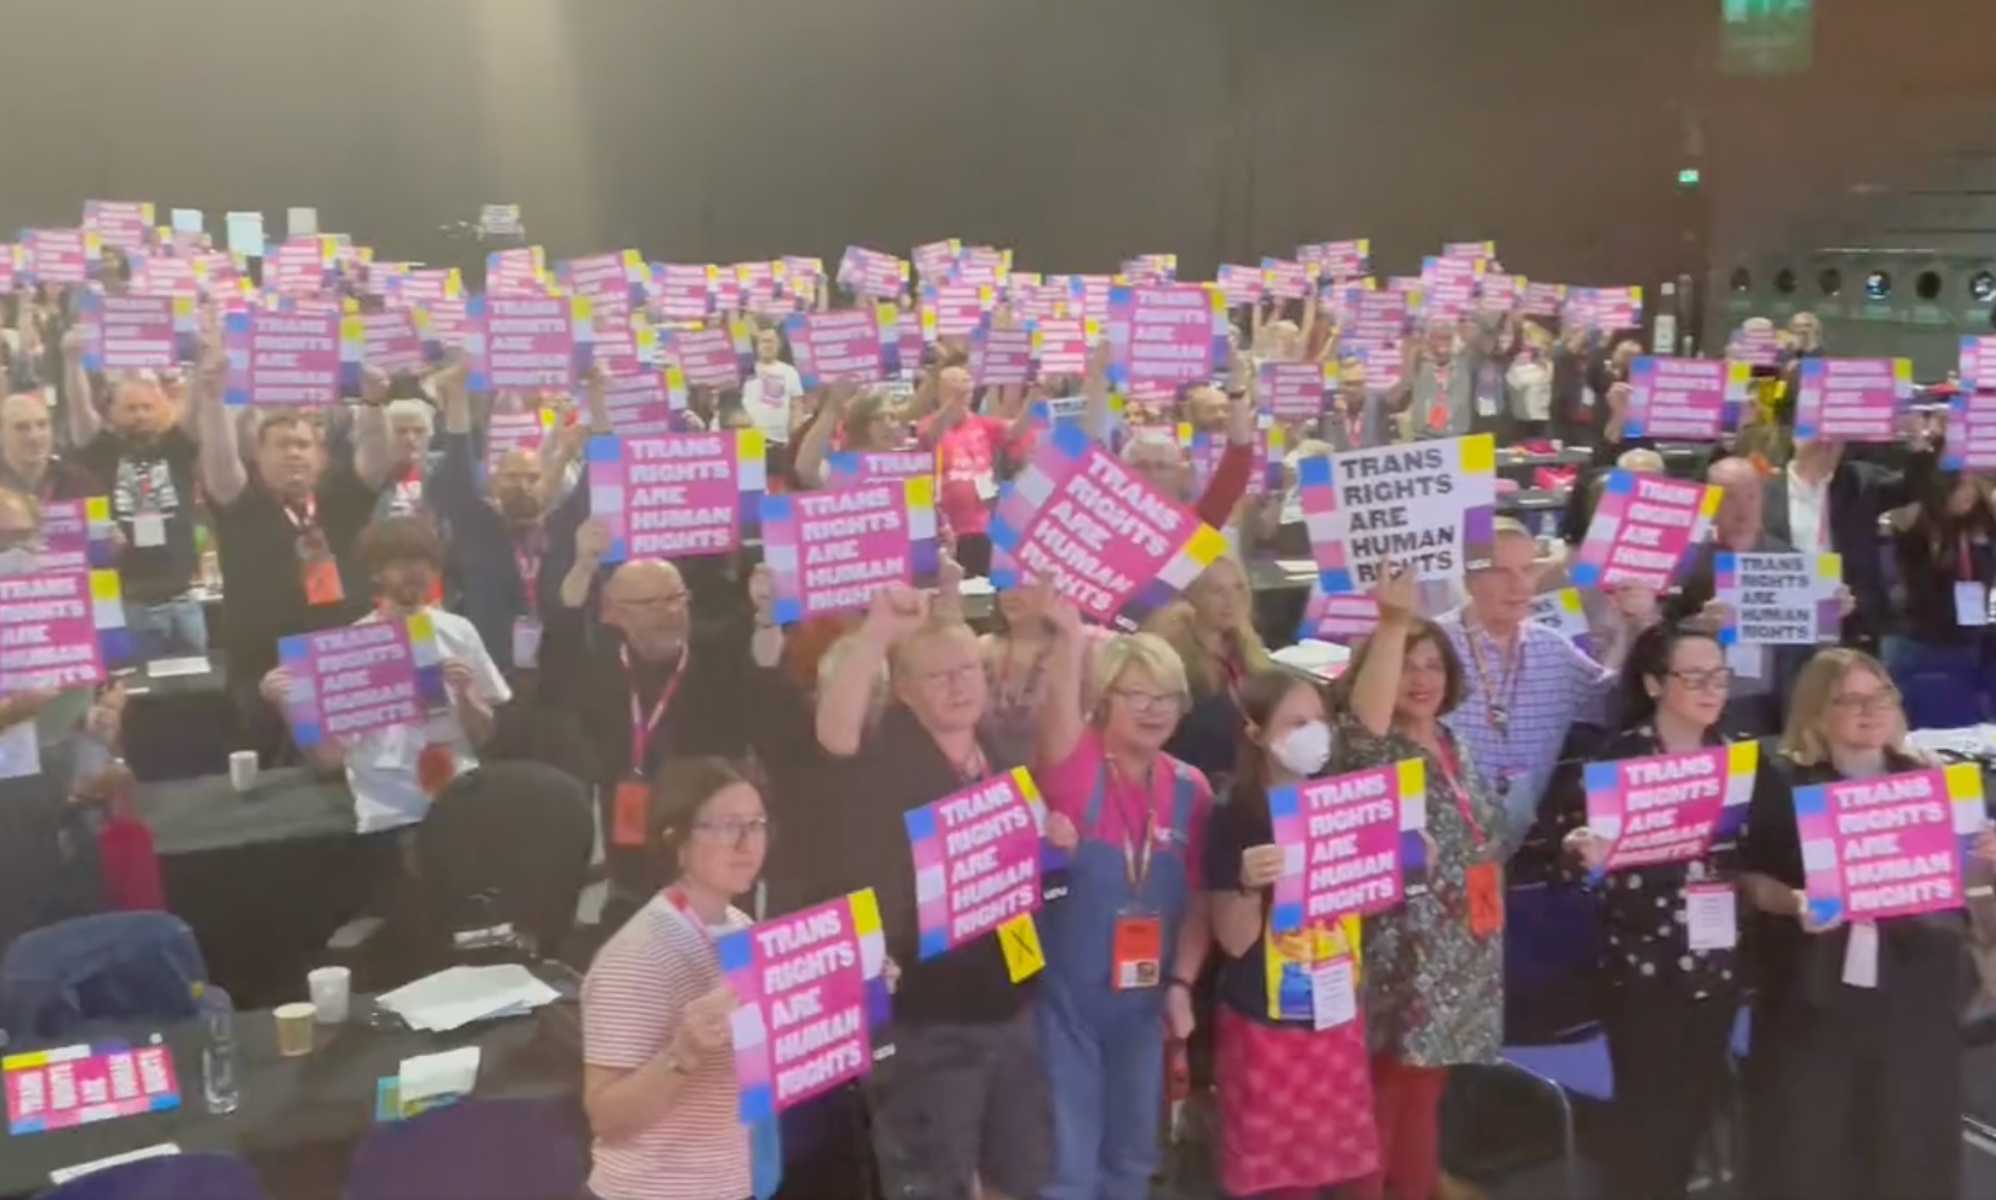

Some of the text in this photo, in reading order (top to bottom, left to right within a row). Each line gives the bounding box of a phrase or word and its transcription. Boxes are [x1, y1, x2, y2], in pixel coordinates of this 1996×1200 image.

[627, 437, 722, 460] TRANS
[1340, 448, 1443, 479] TRANS
[629, 460, 730, 483] RIGHTS
[631, 486, 688, 506] ARE
[799, 487, 890, 516] TRANS
[1087, 450, 1182, 531] TRANS
[1343, 474, 1454, 506] RIGHTS
[631, 507, 732, 530] HUMAN
[803, 511, 900, 541] RIGHTS
[1050, 500, 1111, 551] ARE
[1064, 473, 1170, 557] RIGHTS
[1350, 506, 1409, 533] ARE
[632, 528, 730, 554] RIGHTS
[806, 540, 859, 564] ARE
[1033, 518, 1135, 593] HUMAN
[1352, 525, 1455, 558] HUMAN
[806, 557, 905, 588] HUMAN
[1741, 555, 1803, 571] TRANS
[808, 580, 902, 610] RIGH
[1741, 574, 1809, 588] RIGHTS
[1742, 591, 1776, 605] ARE
[1742, 609, 1809, 622] HUMAN
[1742, 625, 1808, 639] RIGHTS
[1625, 755, 1715, 785] TRANS
[940, 781, 1014, 827] TRANS
[1304, 774, 1386, 810] TRANS
[1627, 777, 1720, 812] RIGHTS
[1833, 776, 1932, 808] TRANS
[946, 805, 1029, 855] RIGHTS
[1308, 799, 1394, 838] RIGHTS
[1625, 808, 1678, 834] ARE
[1838, 801, 1944, 834] RIGHTS
[1311, 834, 1358, 865] ARE
[1844, 833, 1900, 861] ARE
[952, 845, 998, 885] ARE
[1310, 852, 1395, 892] HUMAN
[1846, 851, 1952, 887] HUMAN
[953, 858, 1035, 911] HUMAN
[1308, 877, 1395, 917] RIGHTS
[1850, 877, 1953, 911] RIGHTS
[954, 885, 1035, 939] RIGHTS
[756, 908, 841, 959] TRANS
[764, 940, 855, 995] RIGHTS
[771, 985, 823, 1030] ARE
[774, 1004, 861, 1065] HUMAN
[776, 1038, 862, 1101] RIGHTS
